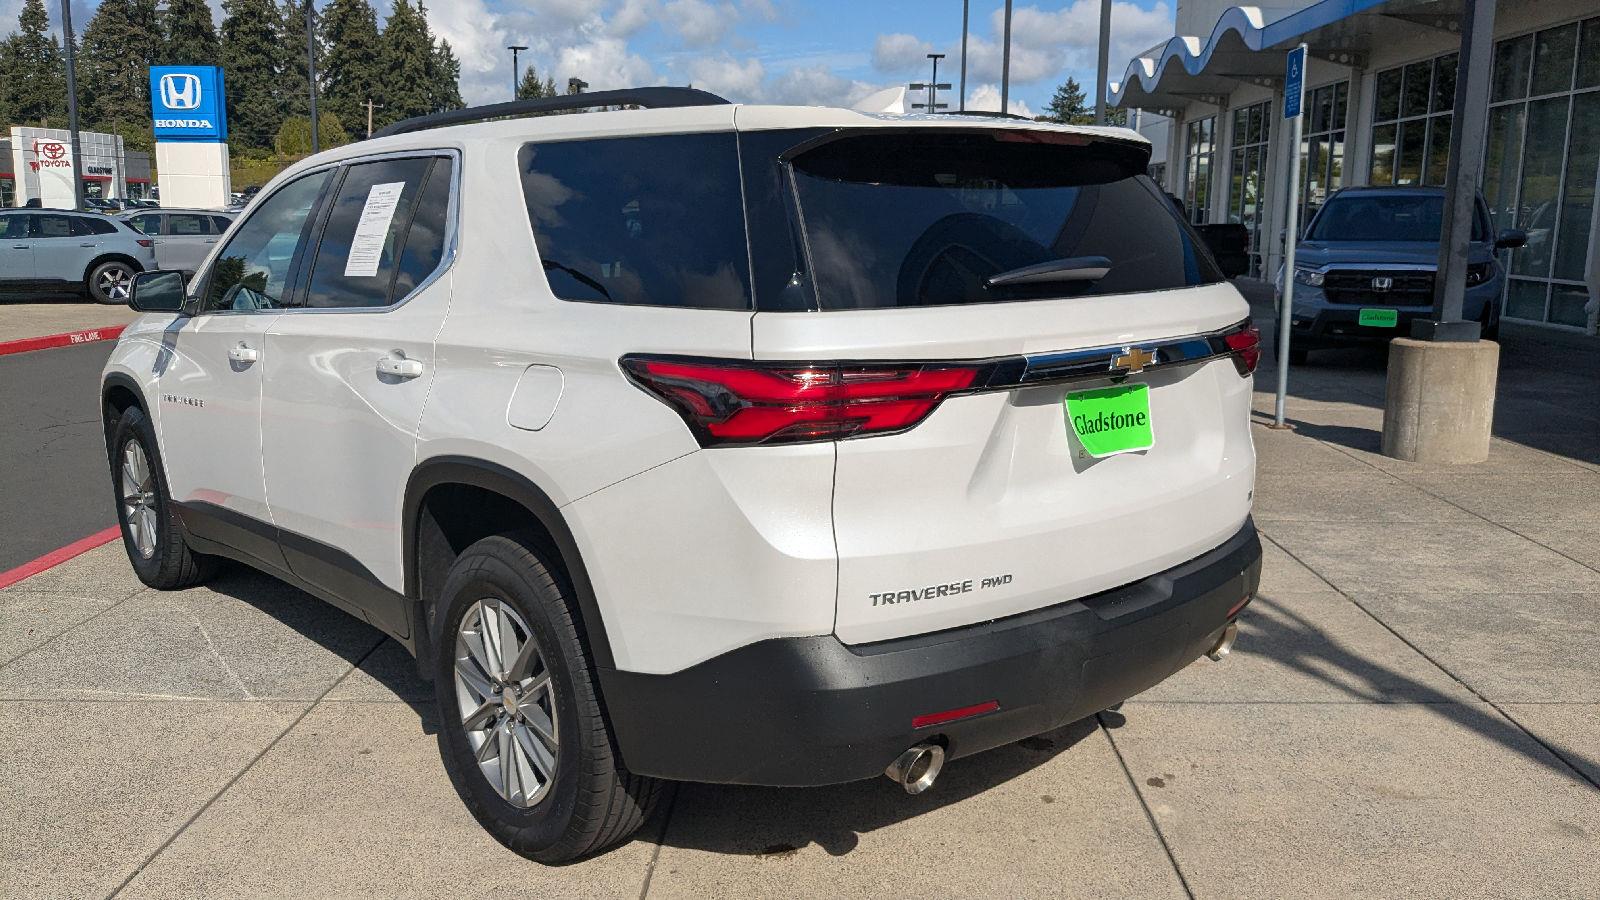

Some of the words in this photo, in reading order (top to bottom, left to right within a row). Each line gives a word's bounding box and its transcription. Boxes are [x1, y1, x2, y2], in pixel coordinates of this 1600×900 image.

[155, 119, 213, 129] HONDA
[40, 160, 71, 168] TOYOTA
[70, 333, 84, 343] FIRE
[84, 331, 100, 342] LANE
[1074, 411, 1146, 436] Gladstone
[869, 580, 973, 607] TRAVERSE
[981, 574, 1013, 589] AWD
